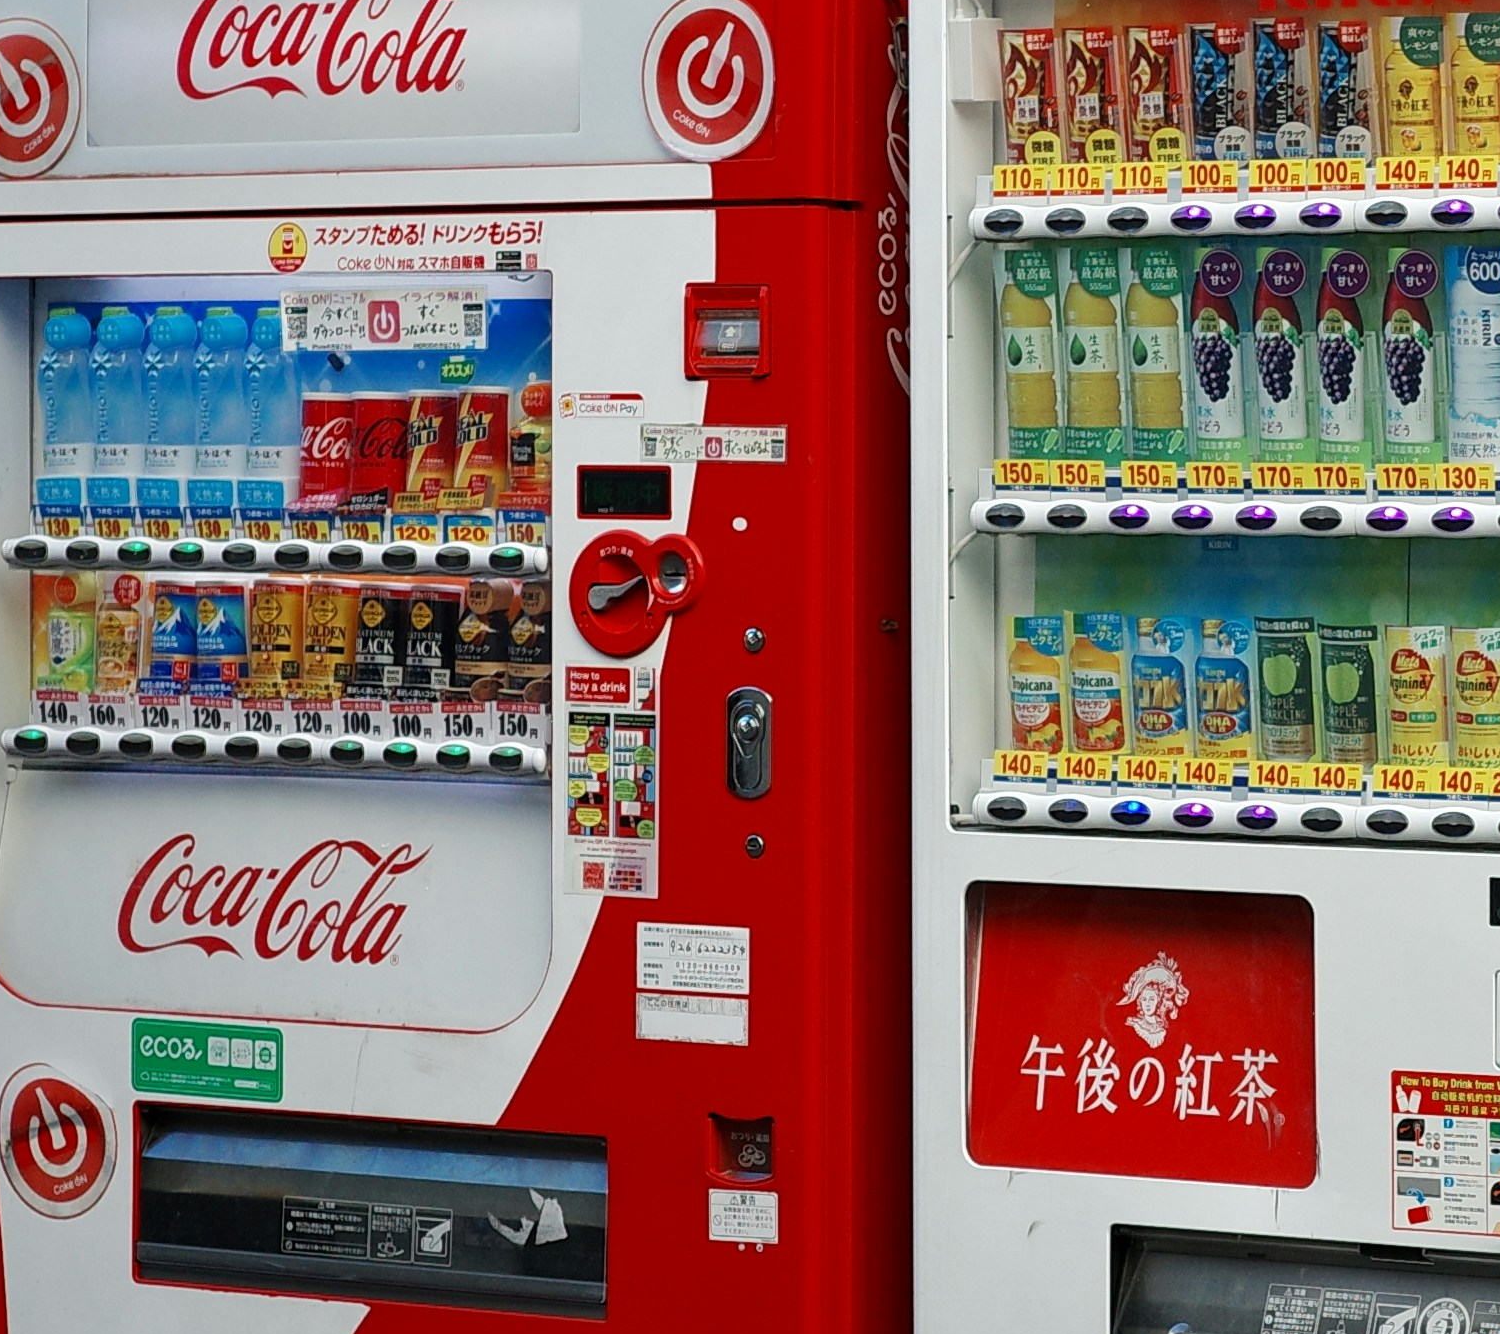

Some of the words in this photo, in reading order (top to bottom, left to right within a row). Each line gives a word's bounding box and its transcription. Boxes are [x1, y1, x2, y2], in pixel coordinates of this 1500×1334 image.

[1216, 88, 1227, 128] BLACK
[1277, 74, 1287, 125] BLACK
[1032, 139, 1054, 153] 微糖
[1092, 139, 1115, 152] 微糖
[1000, 167, 1042, 189] 110円
[1188, 164, 1232, 186] 100円
[1383, 158, 1428, 182] 140円
[314, 223, 426, 246] スタンプためる!
[432, 221, 543, 244] ドリンクもらう!
[338, 256, 371, 270] Coke
[1204, 263, 1237, 274] すっきり
[1332, 263, 1364, 274] すっきり
[1211, 274, 1231, 287] 甘い
[1337, 275, 1359, 288] 甘い
[1001, 462, 1043, 484] 150円
[1193, 466, 1237, 487] 170円
[1444, 467, 1488, 489] 130円
[570, 671, 589, 680] How
[591, 672, 600, 680] to
[570, 682, 589, 693] buy
[592, 684, 598, 692] a
[600, 682, 626, 693] drink
[39, 702, 77, 725] 140円
[89, 706, 125, 727] 160円
[141, 707, 179, 729] 120円
[244, 711, 281, 734] 120円
[294, 712, 332, 734] 120円
[343, 712, 380, 735] 100円
[1143, 715, 1167, 726] DHA
[392, 715, 431, 738] 100円
[444, 715, 483, 738] 150円
[498, 713, 537, 739] 150円
[1000, 753, 1042, 776] 140円
[1184, 761, 1226, 783] 140円
[1440, 770, 1483, 794] 140円
[118, 834, 434, 965] Coca-Cola
[1021, 1035, 1278, 1125] 午後の紅茶
